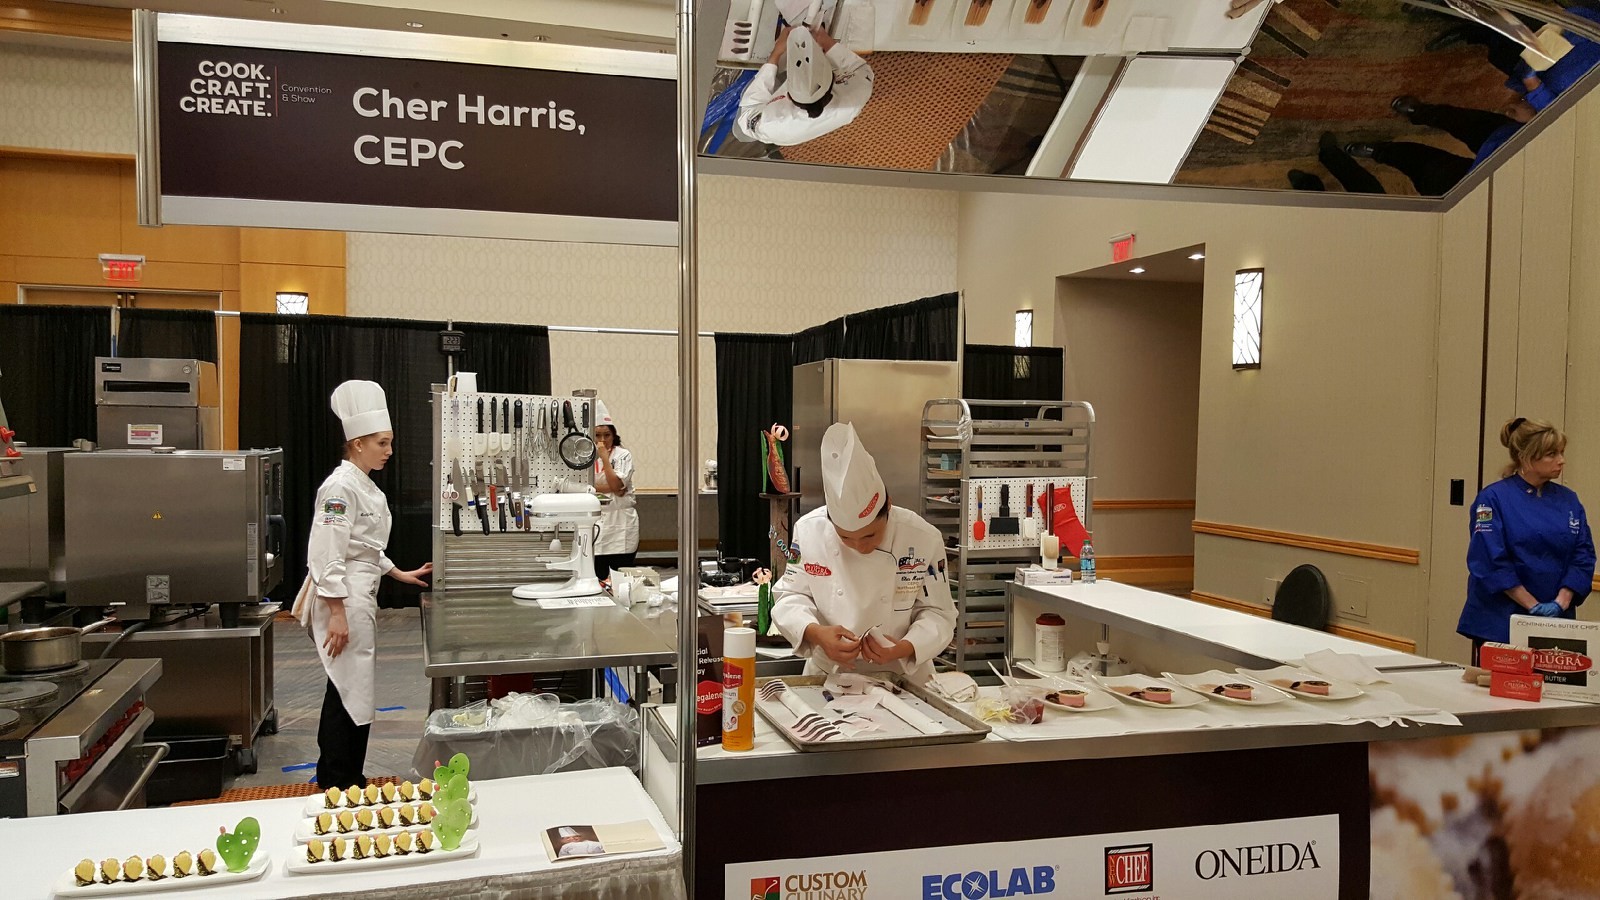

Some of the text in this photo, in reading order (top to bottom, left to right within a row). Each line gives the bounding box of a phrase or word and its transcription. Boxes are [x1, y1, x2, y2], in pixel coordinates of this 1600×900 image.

[198, 60, 272, 81] COOK.
[190, 78, 272, 99] CRAFT.
[281, 83, 332, 95] Convention
[281, 93, 316, 103] & Show
[179, 96, 272, 117] CREATE.
[352, 87, 586, 135] Cher Harris,
[353, 134, 465, 170] CEPC
[109, 260, 137, 280] EXIT
[1544, 675, 1567, 683] BUTTER
[697, 692, 723, 704] egalene
[1116, 853, 1149, 884] CHEF
[1195, 841, 1321, 880] ONEIDA
[785, 870, 868, 892] CUSTOM
[922, 866, 1056, 900] ECOLAB
